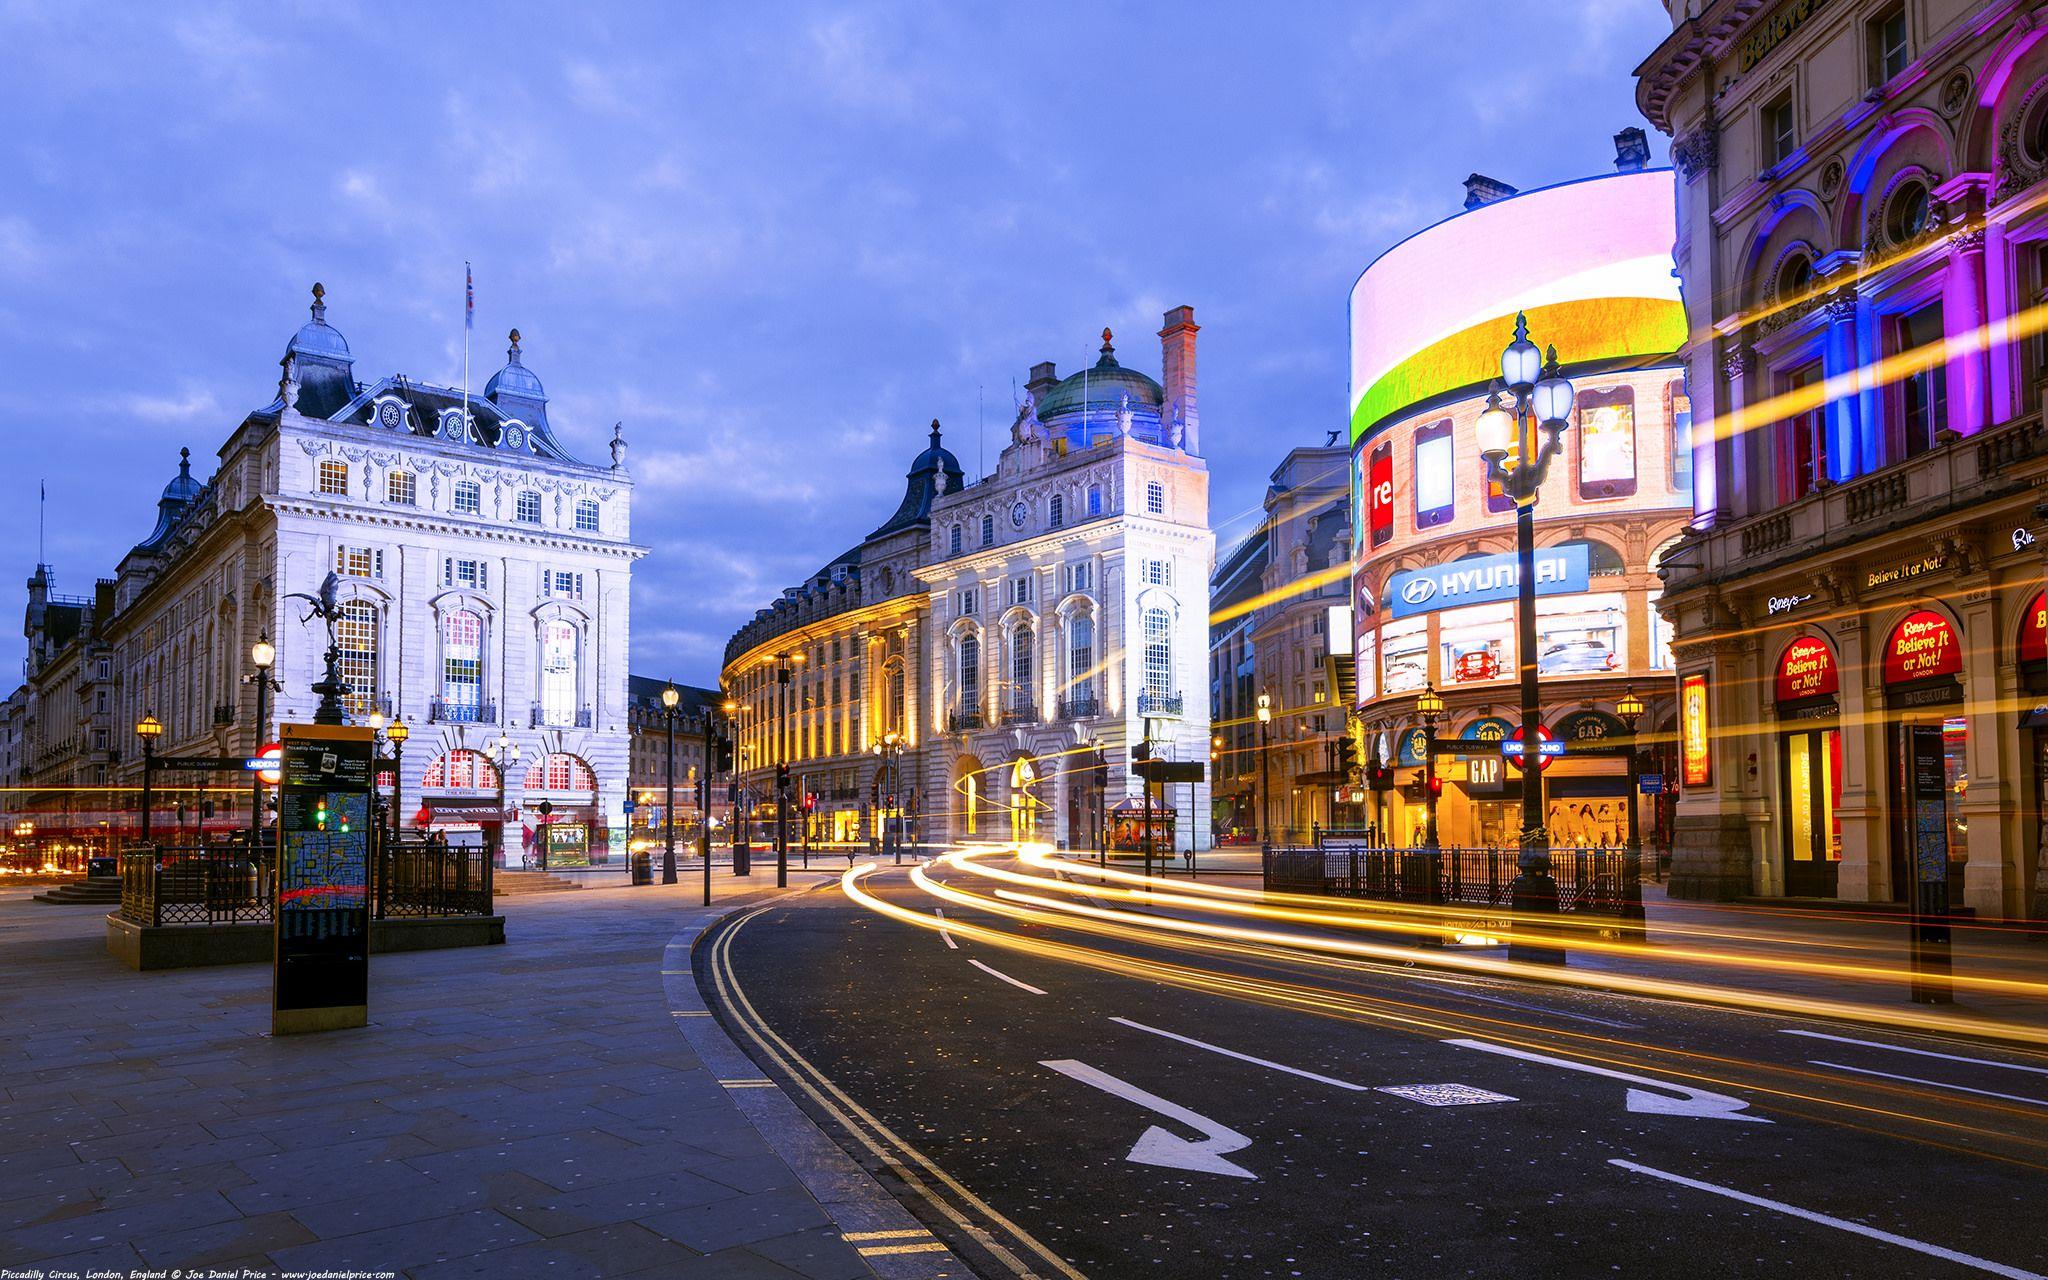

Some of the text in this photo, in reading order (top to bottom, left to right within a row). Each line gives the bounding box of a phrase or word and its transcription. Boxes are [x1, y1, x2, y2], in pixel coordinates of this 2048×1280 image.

[1373, 480, 1392, 509] re
[1442, 558, 1567, 597] HYUNAI
[1868, 556, 1943, 587] Believe It or Not!
[1896, 630, 1949, 656] Believe It
[1786, 654, 1828, 676] Believe It
[1903, 648, 1942, 671] or Not!
[1791, 670, 1823, 690] or Not!
[1912, 669, 1934, 678] LONDON
[1480, 731, 1501, 741] GAP
[1578, 725, 1603, 738] GAP
[1471, 759, 1498, 784] GAP
